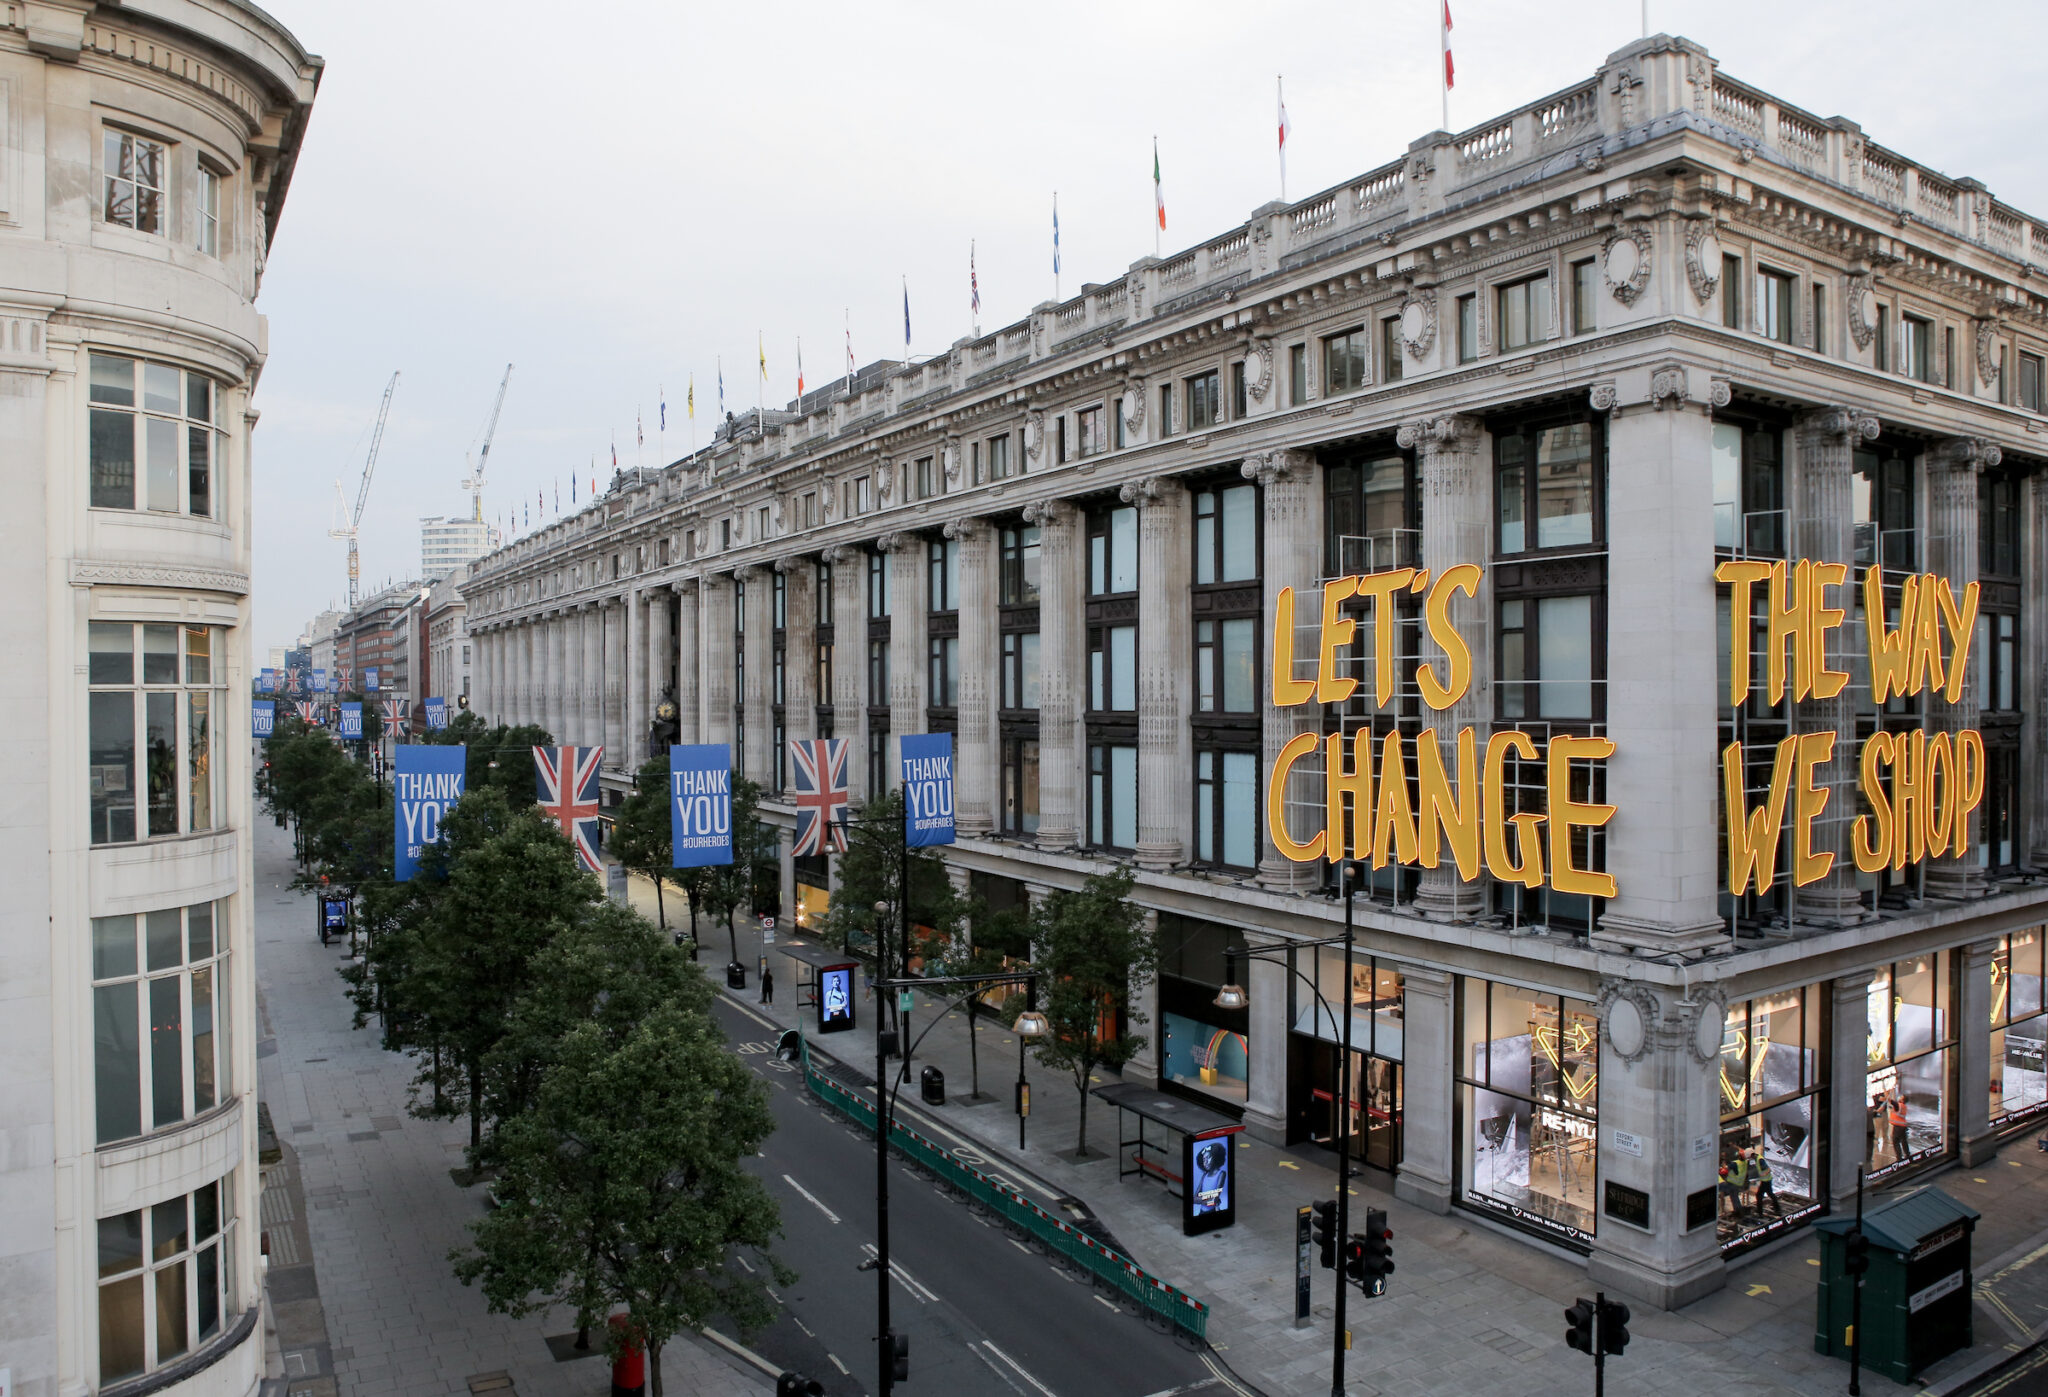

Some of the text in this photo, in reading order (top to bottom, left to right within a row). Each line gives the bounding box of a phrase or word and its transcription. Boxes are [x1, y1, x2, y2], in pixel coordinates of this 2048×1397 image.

[1273, 563, 1483, 711] LET'S
[1714, 558, 1980, 707] THE WAY
[253, 717, 273, 730] YOU
[343, 718, 362, 731] YOU
[427, 712, 446, 726] YOU
[904, 756, 951, 781] THANK
[398, 773, 462, 800] THANK
[673, 769, 728, 795] THANK
[907, 779, 953, 819] YOU
[402, 801, 460, 844] YO
[677, 795, 730, 836] YOU
[914, 815, 954, 831] #OURHEROES
[1268, 726, 1618, 899] CHANGE
[1722, 728, 1985, 896] WE SHOP
[683, 835, 730, 849] #OURHEROES
[1615, 1137, 1632, 1147] STREET
[1616, 1131, 1633, 1142] OXFORD
[1523, 1212, 1544, 1225] PRADA
